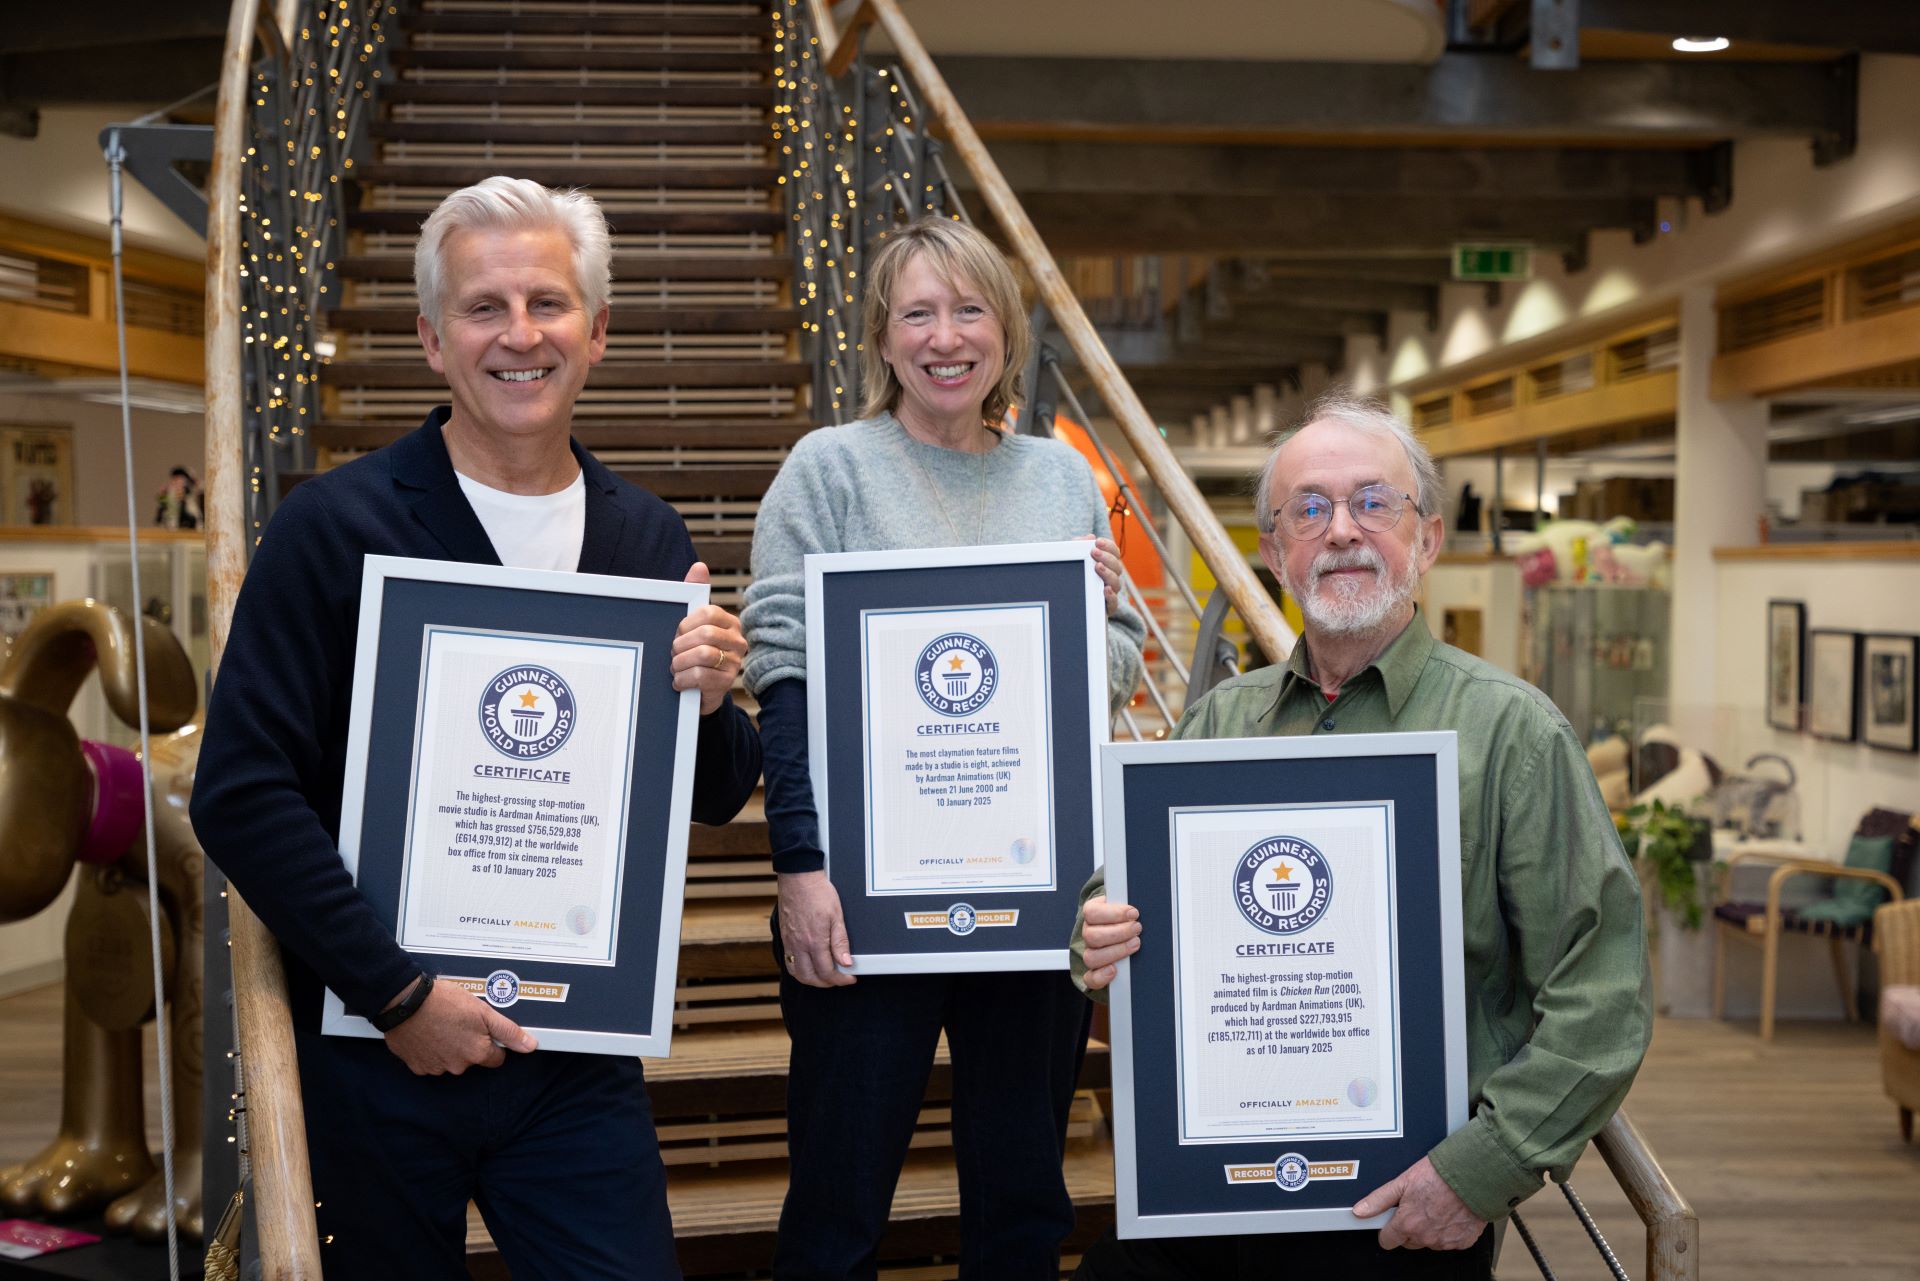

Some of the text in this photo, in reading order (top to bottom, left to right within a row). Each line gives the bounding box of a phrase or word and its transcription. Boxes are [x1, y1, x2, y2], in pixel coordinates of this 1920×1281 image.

[926, 638, 986, 661] GUINNESS
[495, 671, 565, 698] GUINNESS
[920, 668, 994, 712] WORLD RECORDS
[484, 704, 571, 755] WORLD RECORDS
[917, 722, 1000, 734] CERTIFICATE
[906, 746, 1019, 758] The most claymation feature films
[905, 762, 923, 771] made
[925, 762, 933, 771] by
[940, 760, 961, 769] studio
[963, 760, 968, 768] is
[970, 760, 990, 770] eight,
[991, 759, 1021, 768] achieved
[474, 764, 571, 782] CERTIFICATE
[915, 771, 1011, 784] by Aardman Animations (UK)
[920, 784, 1008, 795] between 21 June 2000 and
[456, 790, 585, 810] The highest-grossing stop-motion
[937, 797, 991, 807] 10 January 2025
[439, 805, 461, 814] movie
[464, 806, 487, 816] studio
[490, 808, 497, 817] is
[499, 808, 533, 820] Aardman
[535, 811, 578, 824] Animations
[455, 819, 478, 830] which
[480, 821, 493, 831] has
[495, 823, 525, 833] grossed
[515, 839, 523, 847] at
[524, 839, 537, 849] the
[539, 840, 578, 852] worldwide
[448, 846, 583, 866] box office from six cinema releases
[919, 856, 1003, 866] OFFICIALLY AMAZING
[1246, 842, 1318, 869] GUINNESS
[472, 864, 557, 878] as of 10 January 2025
[1239, 878, 1327, 930] WORLD RECORDS
[459, 916, 557, 929] OFFICIALLY AMAZING
[913, 914, 1010, 924] RECORD HOLDER
[1236, 942, 1335, 956] CERTIFICATE
[1221, 970, 1353, 985] The highest-grossing stop-motion
[521, 987, 558, 996] HOLDER
[1213, 988, 1250, 999] animated
[1252, 987, 1268, 997] film
[1270, 987, 1278, 997] is
[1280, 985, 1312, 996] Chicken
[1314, 985, 1330, 995] Run
[1211, 1002, 1248, 1015] produced
[1250, 1001, 1259, 1012] by
[1262, 1001, 1297, 1011] Aardman
[1299, 999, 1343, 1010] Animations
[1225, 1016, 1248, 1027] which
[1250, 1016, 1264, 1026] had
[1266, 1015, 1298, 1027] grossed
[1264, 1031, 1273, 1040] at
[1275, 1030, 1288, 1040] the
[1290, 1028, 1330, 1039] worldwide
[1332, 1028, 1346, 1037] box
[1348, 1027, 1370, 1037] office
[1246, 1042, 1333, 1055] as of 10 January 2025
[1239, 1098, 1339, 1109] OFFICIALLY AMAZING
[1234, 1166, 1349, 1178] RECORD HOLDER
